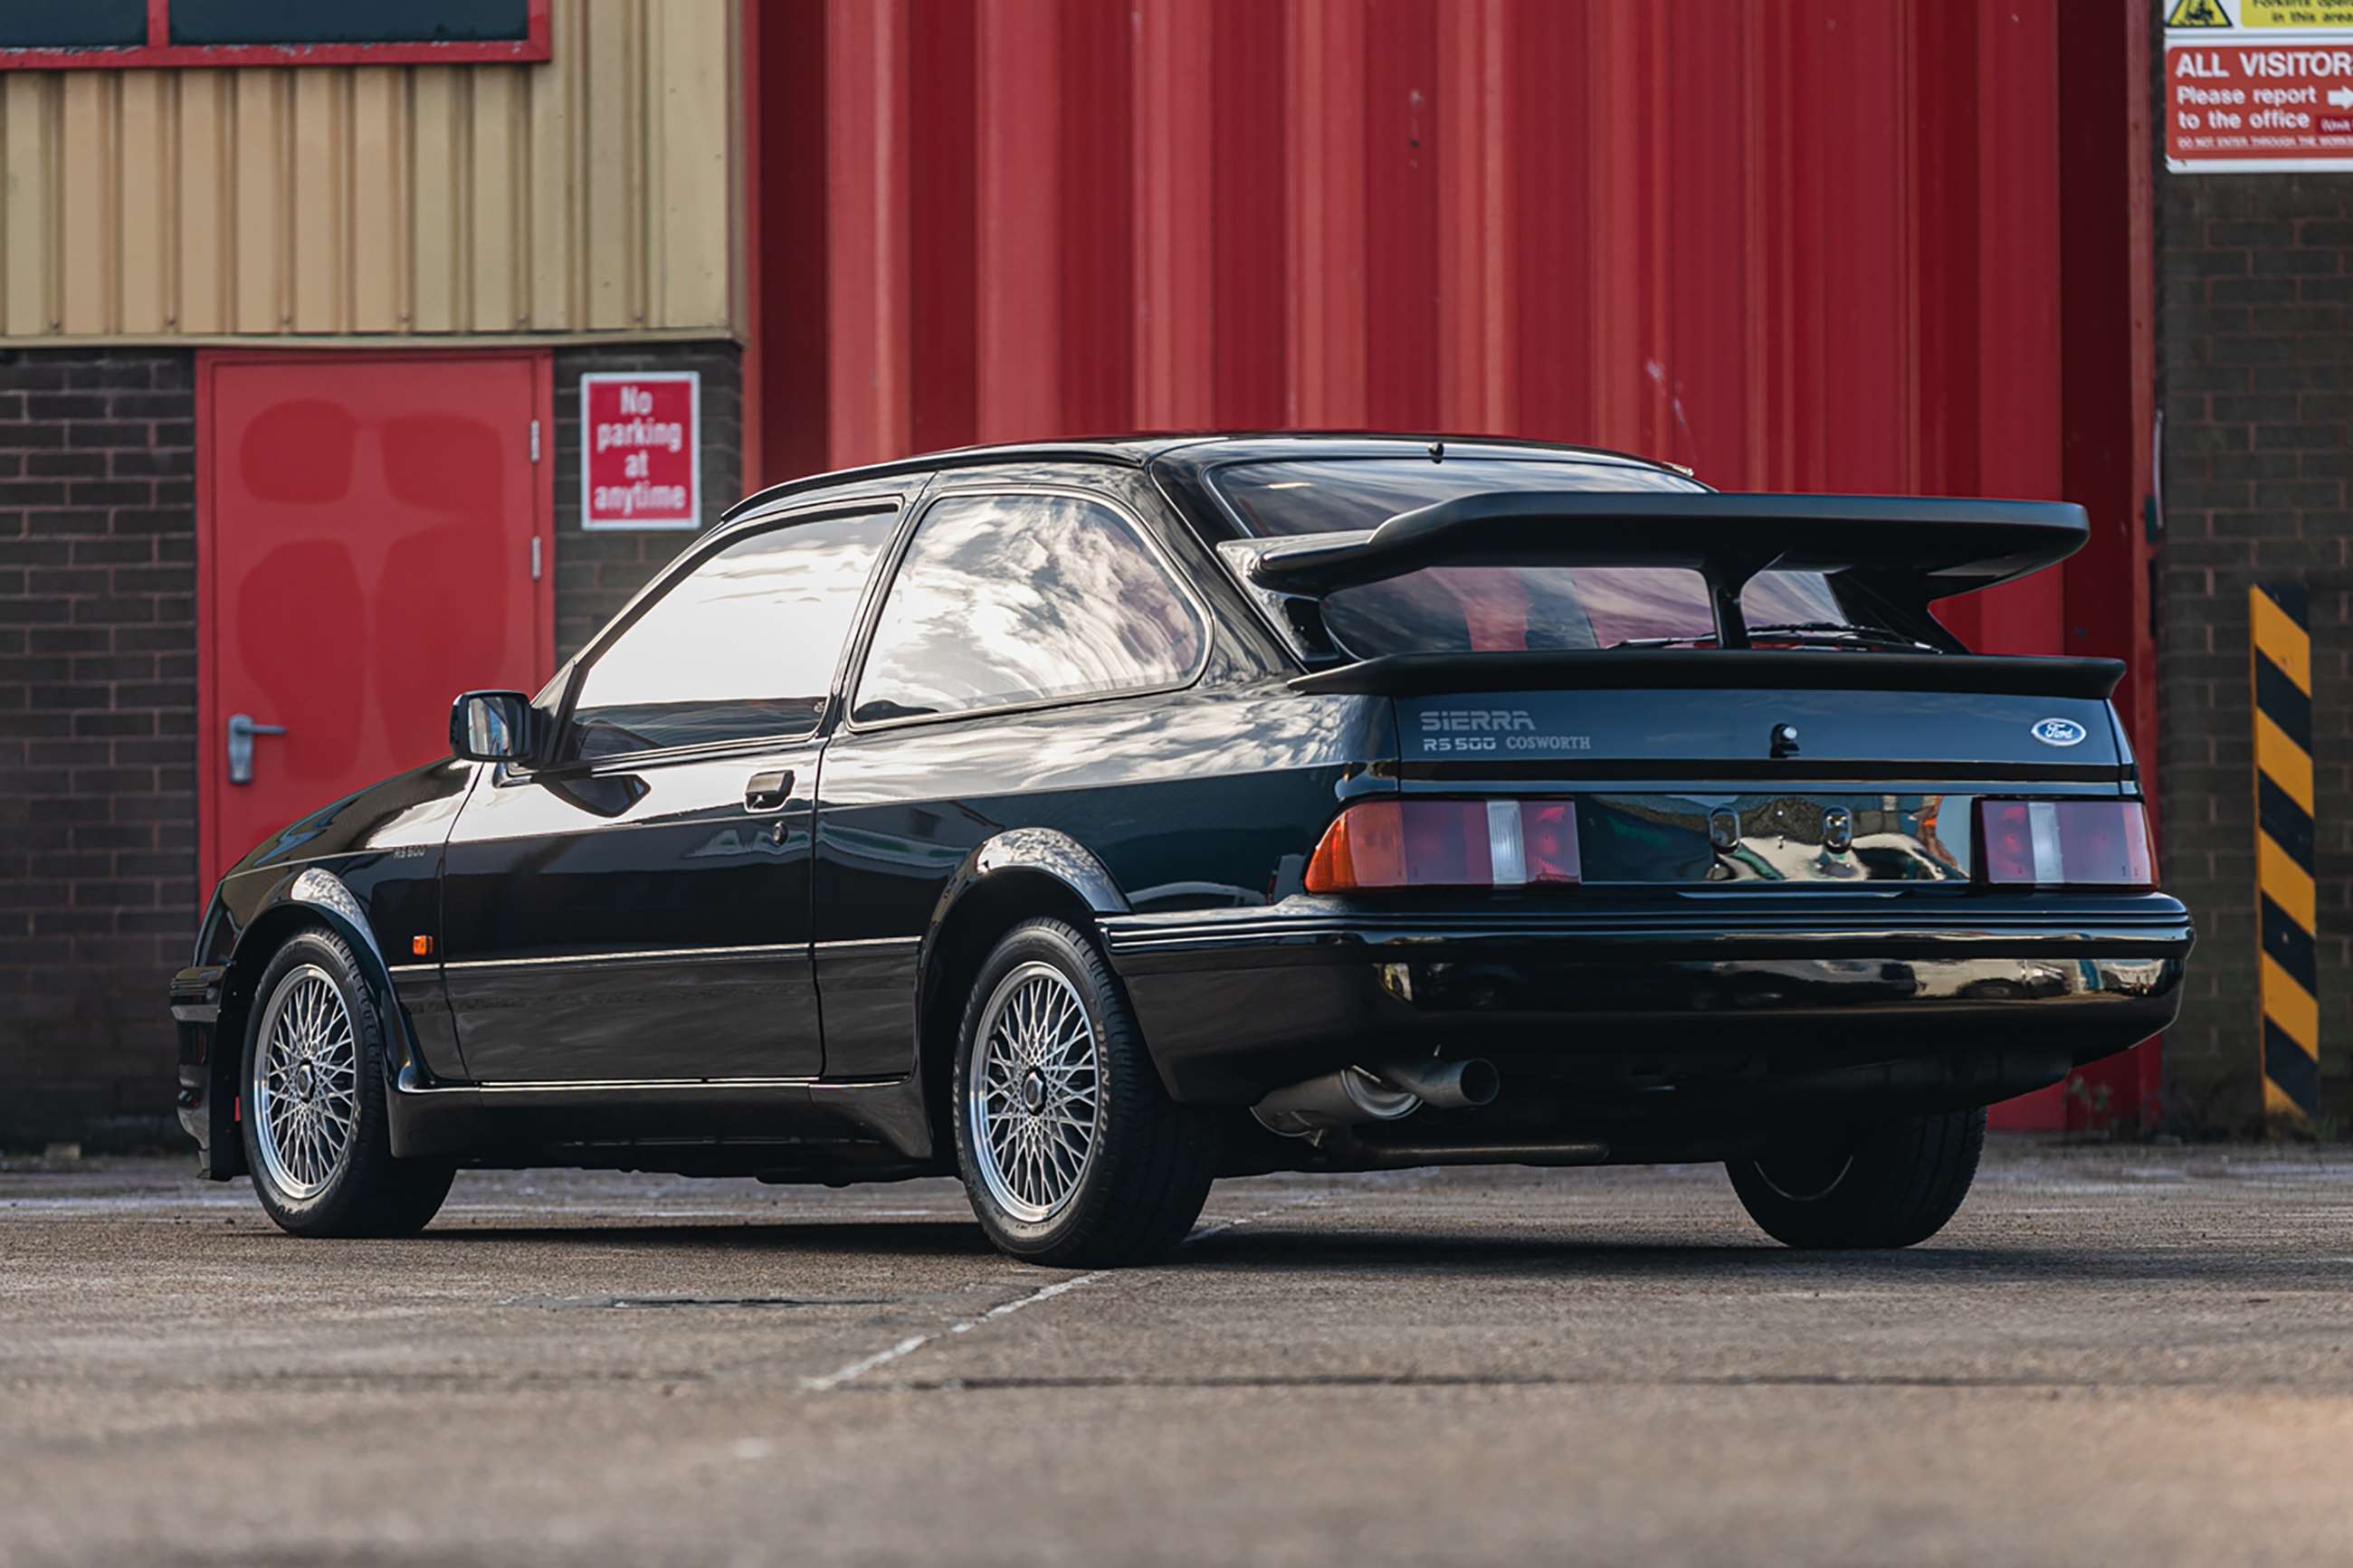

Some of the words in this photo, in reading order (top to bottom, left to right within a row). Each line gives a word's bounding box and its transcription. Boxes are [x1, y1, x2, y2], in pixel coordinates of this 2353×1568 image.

[2272, 13, 2284, 23] in
[2290, 12, 2316, 23] this
[2176, 52, 2230, 78] ALL
[2239, 52, 2353, 78] VISITOR
[2177, 85, 2245, 105] Please
[2253, 86, 2317, 107] report
[2177, 110, 2200, 129] to
[2207, 109, 2242, 129] the
[2249, 109, 2310, 129] office
[620, 385, 653, 415] No
[596, 416, 682, 453] parking
[624, 450, 649, 478] at
[594, 480, 686, 516] anytime
[1420, 710, 1538, 731] SIERRA
[1506, 736, 1592, 750] COSWORTH
